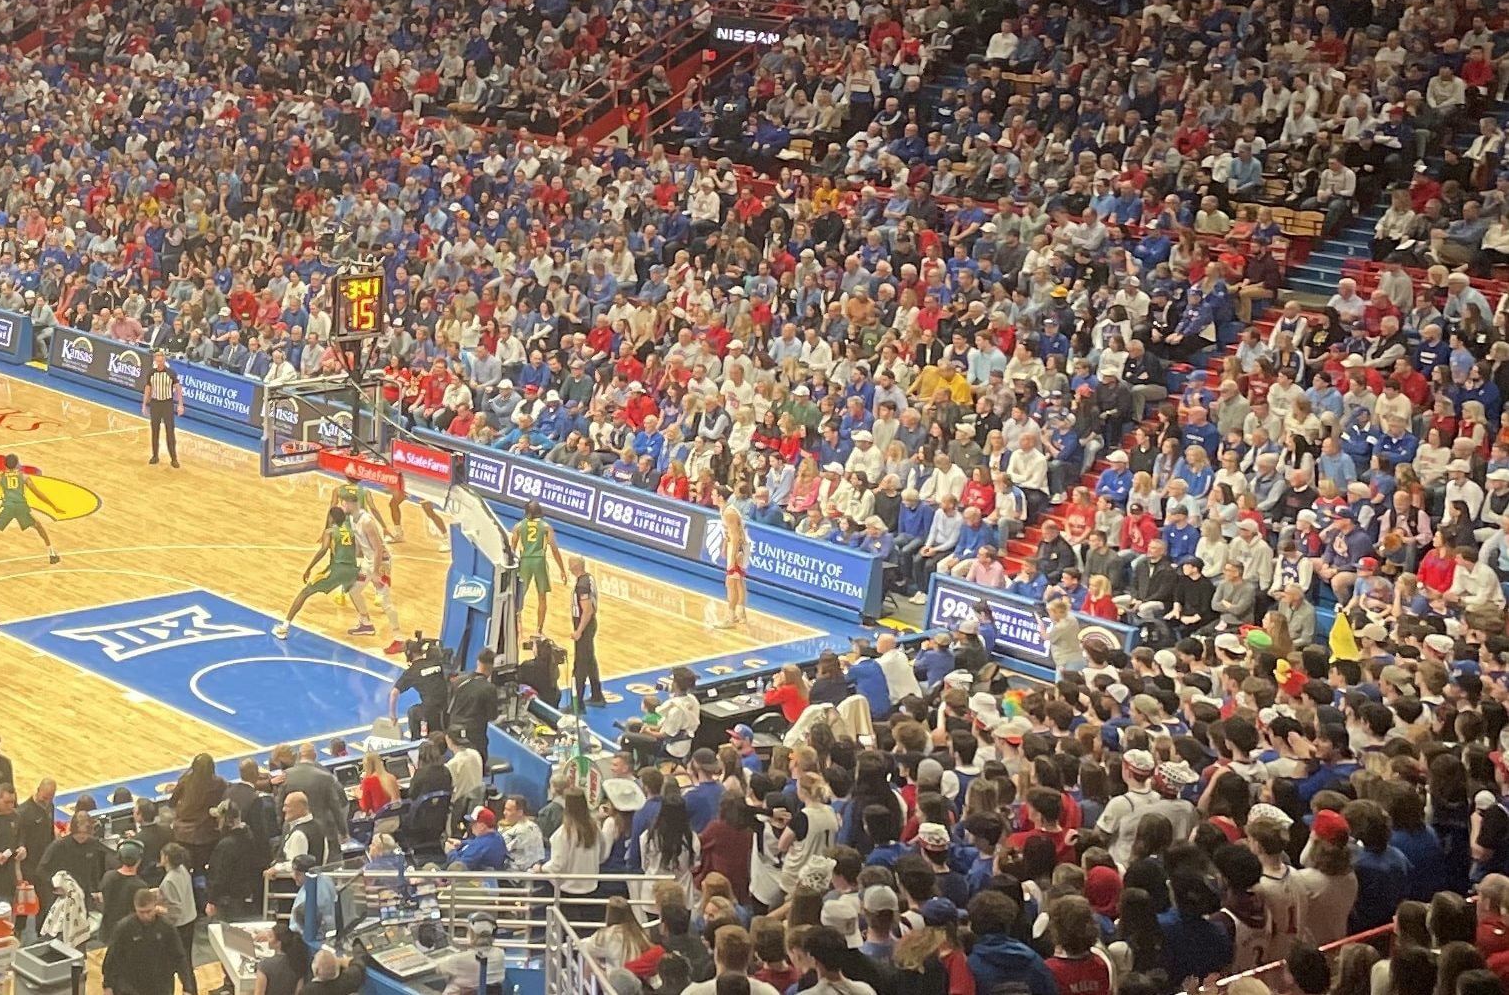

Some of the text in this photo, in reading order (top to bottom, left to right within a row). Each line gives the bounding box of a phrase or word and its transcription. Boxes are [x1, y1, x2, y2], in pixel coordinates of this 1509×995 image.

[716, 27, 781, 45] NISSAN
[348, 277, 381, 300] 3:41
[351, 298, 376, 330] 15
[61, 339, 94, 365] Kansas
[107, 352, 142, 378] Kansas
[185, 376, 238, 398] UNIVERSITY OF
[195, 390, 251, 416] HEALTH SYSTEM
[6, 476, 19, 489] 10
[513, 473, 541, 497] 988
[542, 489, 585, 510] LIFELINE
[603, 500, 633, 525] 988
[527, 527, 537, 542] 2
[633, 517, 680, 539] LIFELINE
[759, 541, 843, 576] UNIVERSITY OF
[775, 560, 863, 599] HEALTH SYSTEM
